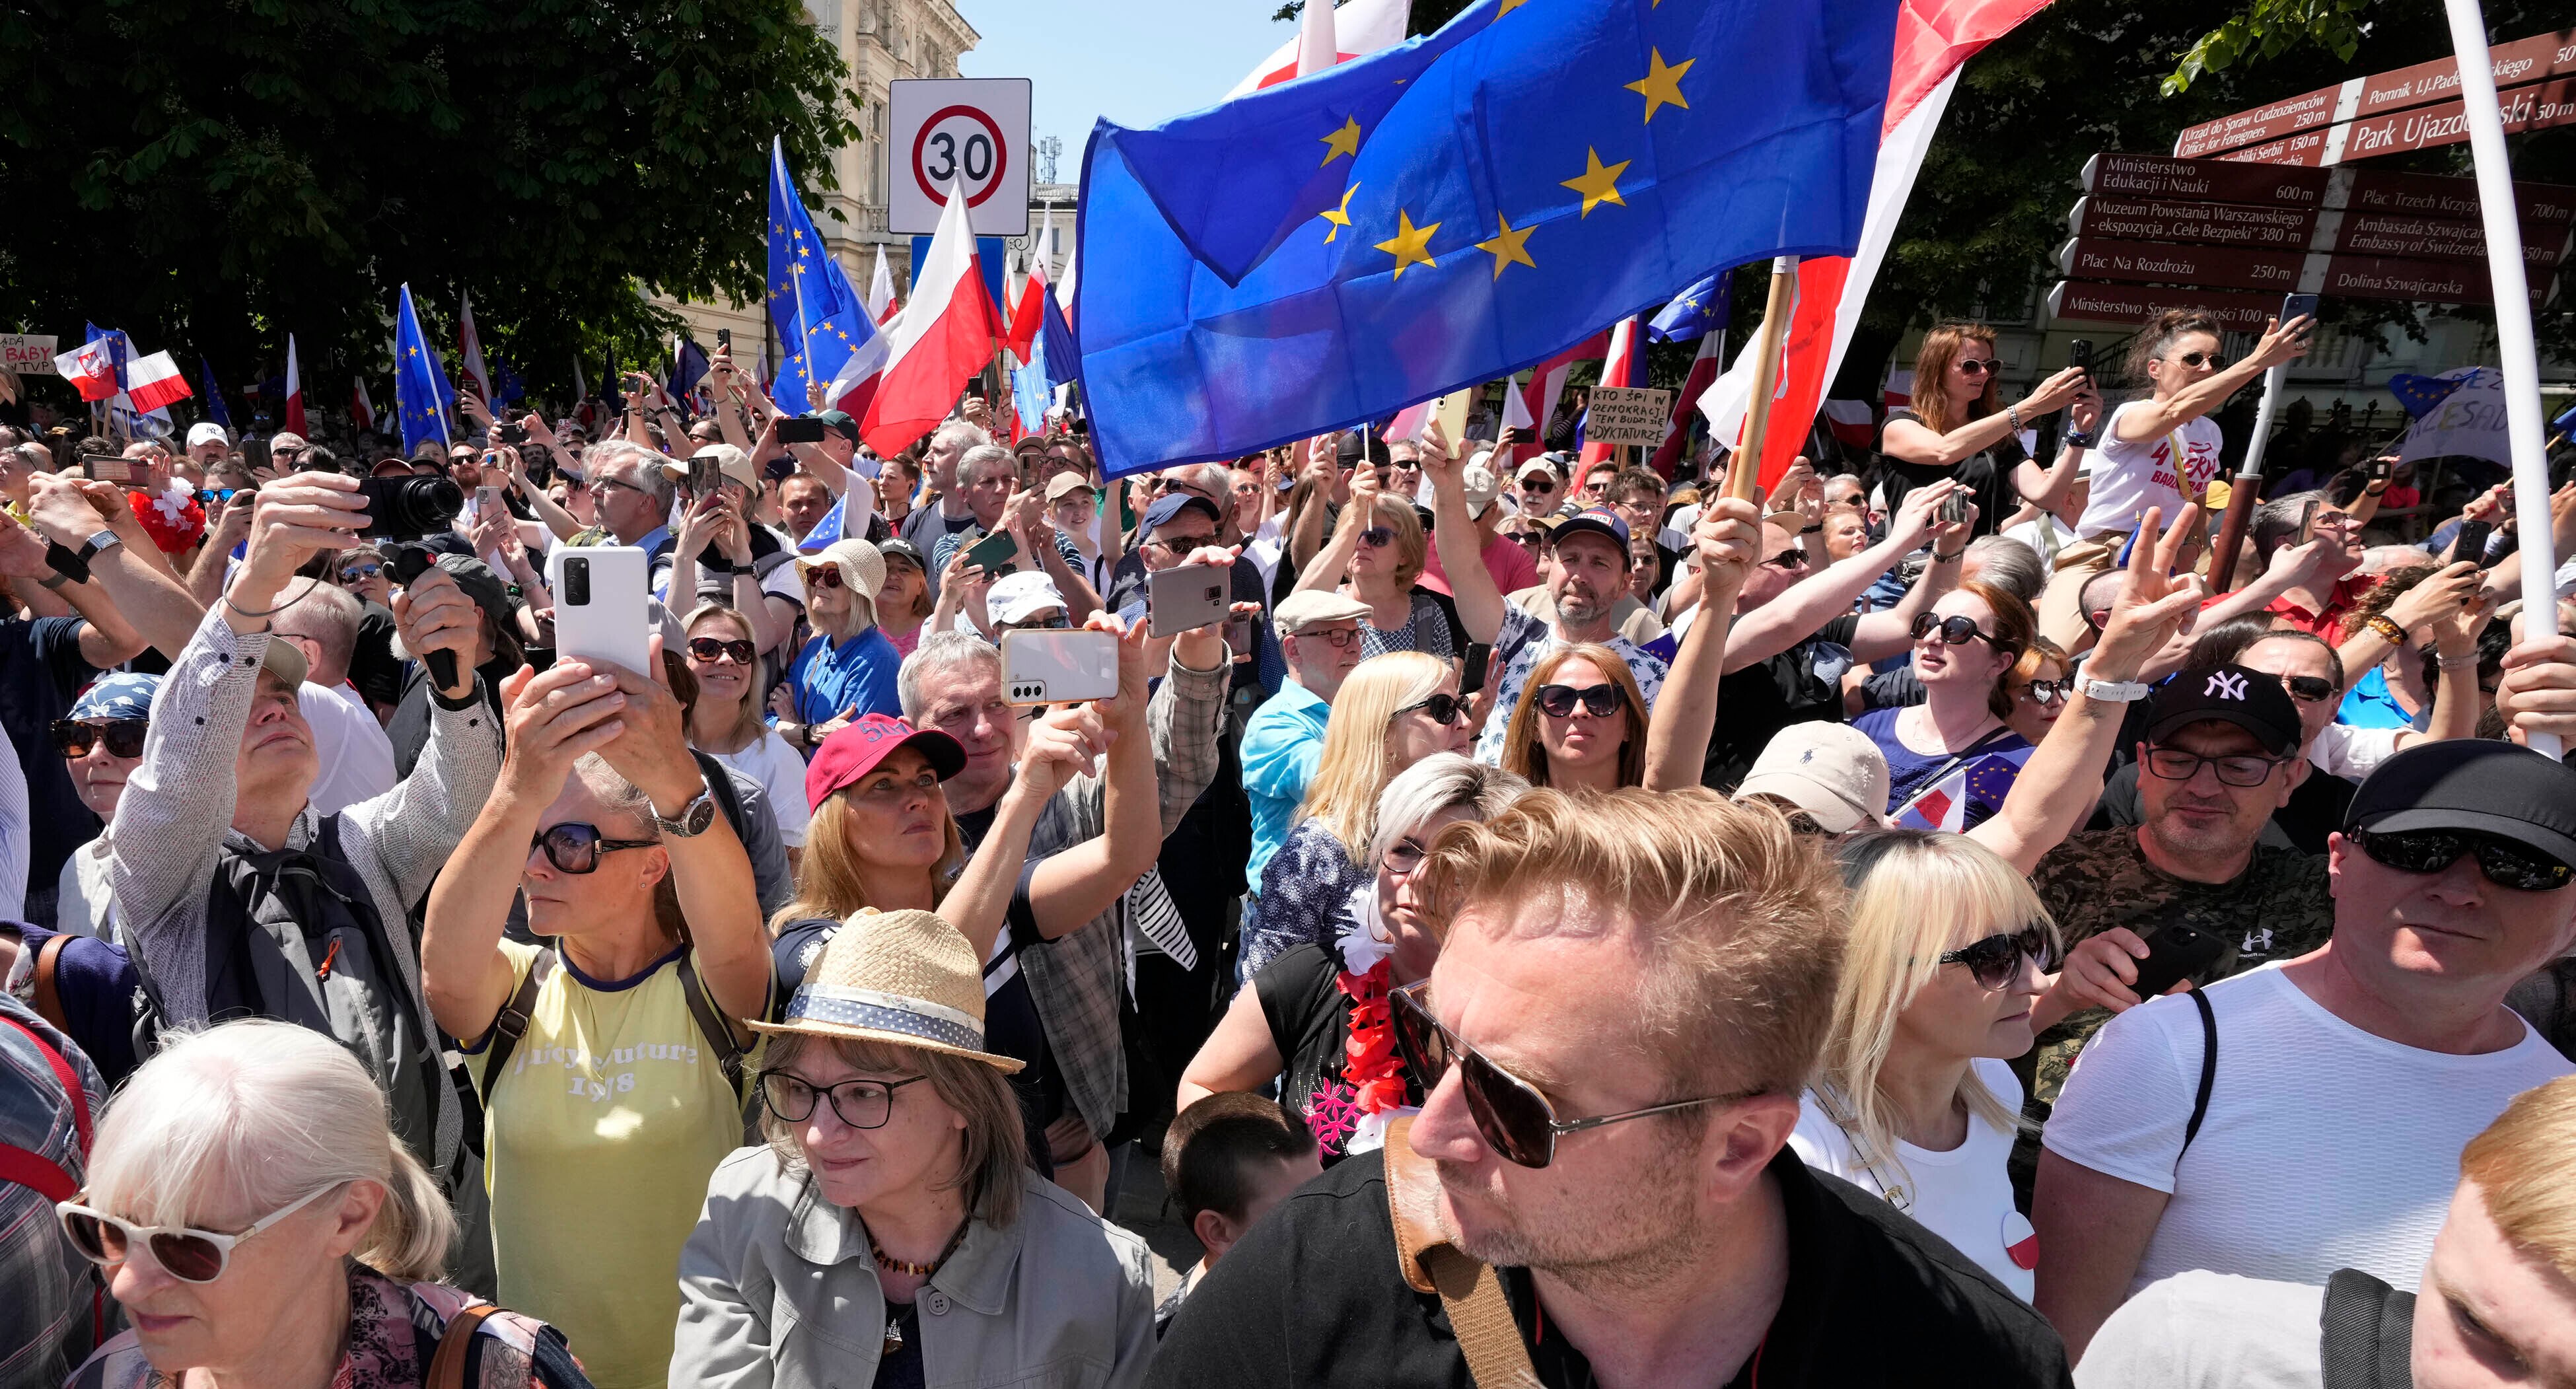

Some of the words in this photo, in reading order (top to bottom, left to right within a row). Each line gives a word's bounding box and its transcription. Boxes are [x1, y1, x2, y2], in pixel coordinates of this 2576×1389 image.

[2369, 82, 2412, 105] Pomnik
[2416, 57, 2533, 96] I.J.Padekiego
[2186, 122, 2210, 143] Urząd
[2211, 121, 2223, 134] do
[2225, 115, 2252, 137] Spraw
[2254, 94, 2327, 123] Cudzoziemców
[2353, 120, 2397, 152] Park
[2404, 93, 2534, 149] Ujazdski
[2535, 102, 2556, 122] 50
[2557, 102, 2573, 117] m
[2181, 143, 2205, 157] Office
[2206, 137, 2219, 151] for
[2221, 125, 2267, 147] Foreigners
[2293, 112, 2314, 127] 250
[2314, 111, 2326, 122] m
[928, 132, 992, 181] 30
[2257, 142, 2285, 160] Serbii
[2291, 136, 2308, 152] 150
[2308, 135, 2320, 147] m
[2106, 158, 2196, 176] Ministerstwo
[2103, 174, 2160, 194] Edukacji
[2162, 178, 2168, 190] i
[2170, 178, 2210, 194] Nauki
[2276, 186, 2300, 200] 600
[2301, 190, 2314, 201] m
[2093, 200, 2147, 216] Muzeum
[2151, 204, 2210, 221] Powstania
[2213, 207, 2304, 229] Warszawskiego
[2362, 190, 2389, 205] Plac
[2394, 192, 2436, 209] Trzech
[2531, 203, 2555, 218] 700
[2555, 209, 2568, 220] m
[2098, 218, 2163, 238] ekspozycja
[2260, 227, 2284, 242] 380
[2287, 232, 2301, 243] m
[2354, 217, 2423, 236] Ambasada
[2426, 222, 2486, 242] Szwajcar
[2349, 234, 2408, 255] Embassy
[2410, 237, 2428, 252] of
[2425, 238, 2488, 257] Switzerla
[2542, 251, 2555, 261] m
[2081, 254, 2108, 269] Plac
[2113, 256, 2131, 270] Na
[2137, 257, 2195, 275] Rozdrożu
[2251, 265, 2276, 279] 250
[2277, 269, 2291, 281] m
[2338, 273, 2382, 289] Dolina
[2384, 276, 2463, 295] Szwajcarska
[2069, 297, 2143, 315] Ministerstwo
[2238, 308, 2262, 323] 100
[6, 345, 52, 362] BABY
[1594, 390, 1618, 401] KTO
[1655, 396, 1666, 405] W
[1596, 414, 1616, 423] TEN
[1593, 425, 1664, 443] DYKTATURZE
[2151, 442, 2170, 466] 4
[882, 538, 912, 551] NASA
